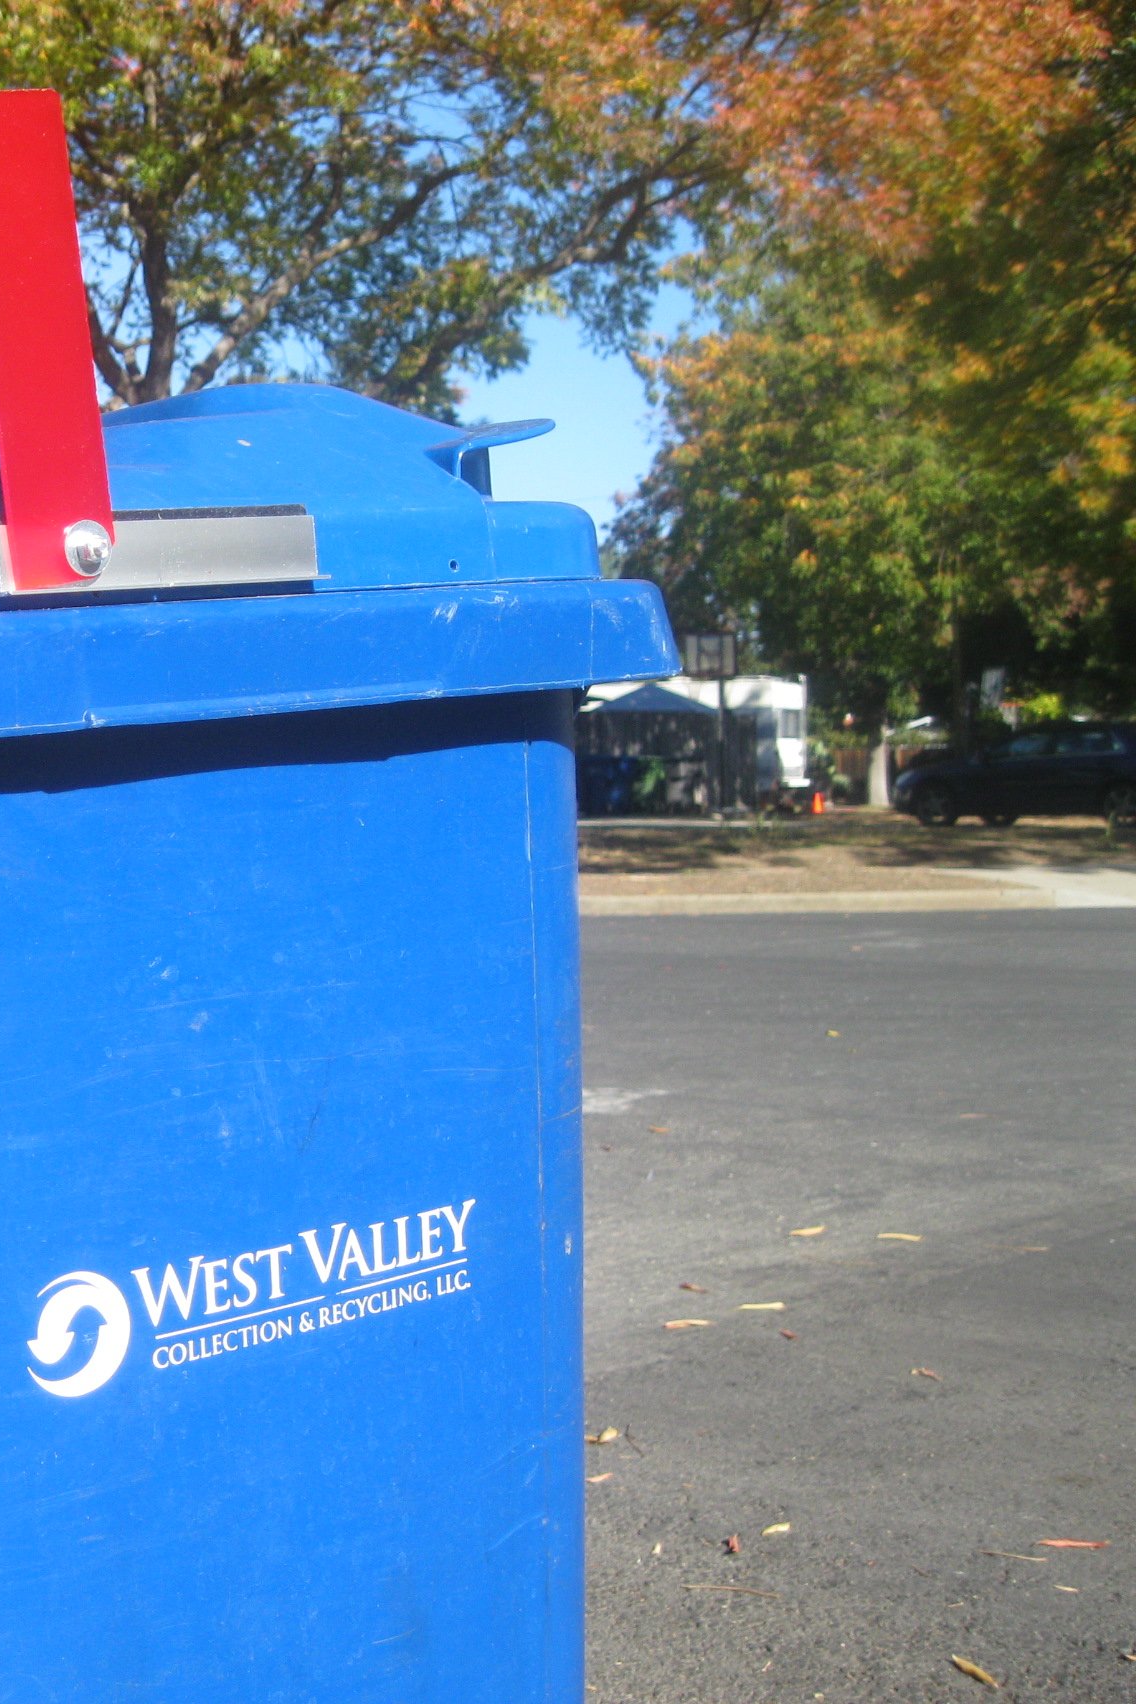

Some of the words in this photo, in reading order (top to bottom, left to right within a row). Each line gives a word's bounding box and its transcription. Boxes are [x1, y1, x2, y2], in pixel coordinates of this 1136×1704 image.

[130, 1243, 294, 1328] WEST
[298, 1198, 477, 1284] VALLEY
[152, 1315, 294, 1370] COLLECTION
[298, 1311, 316, 1333] &
[318, 1281, 432, 1329] RECYCLING,
